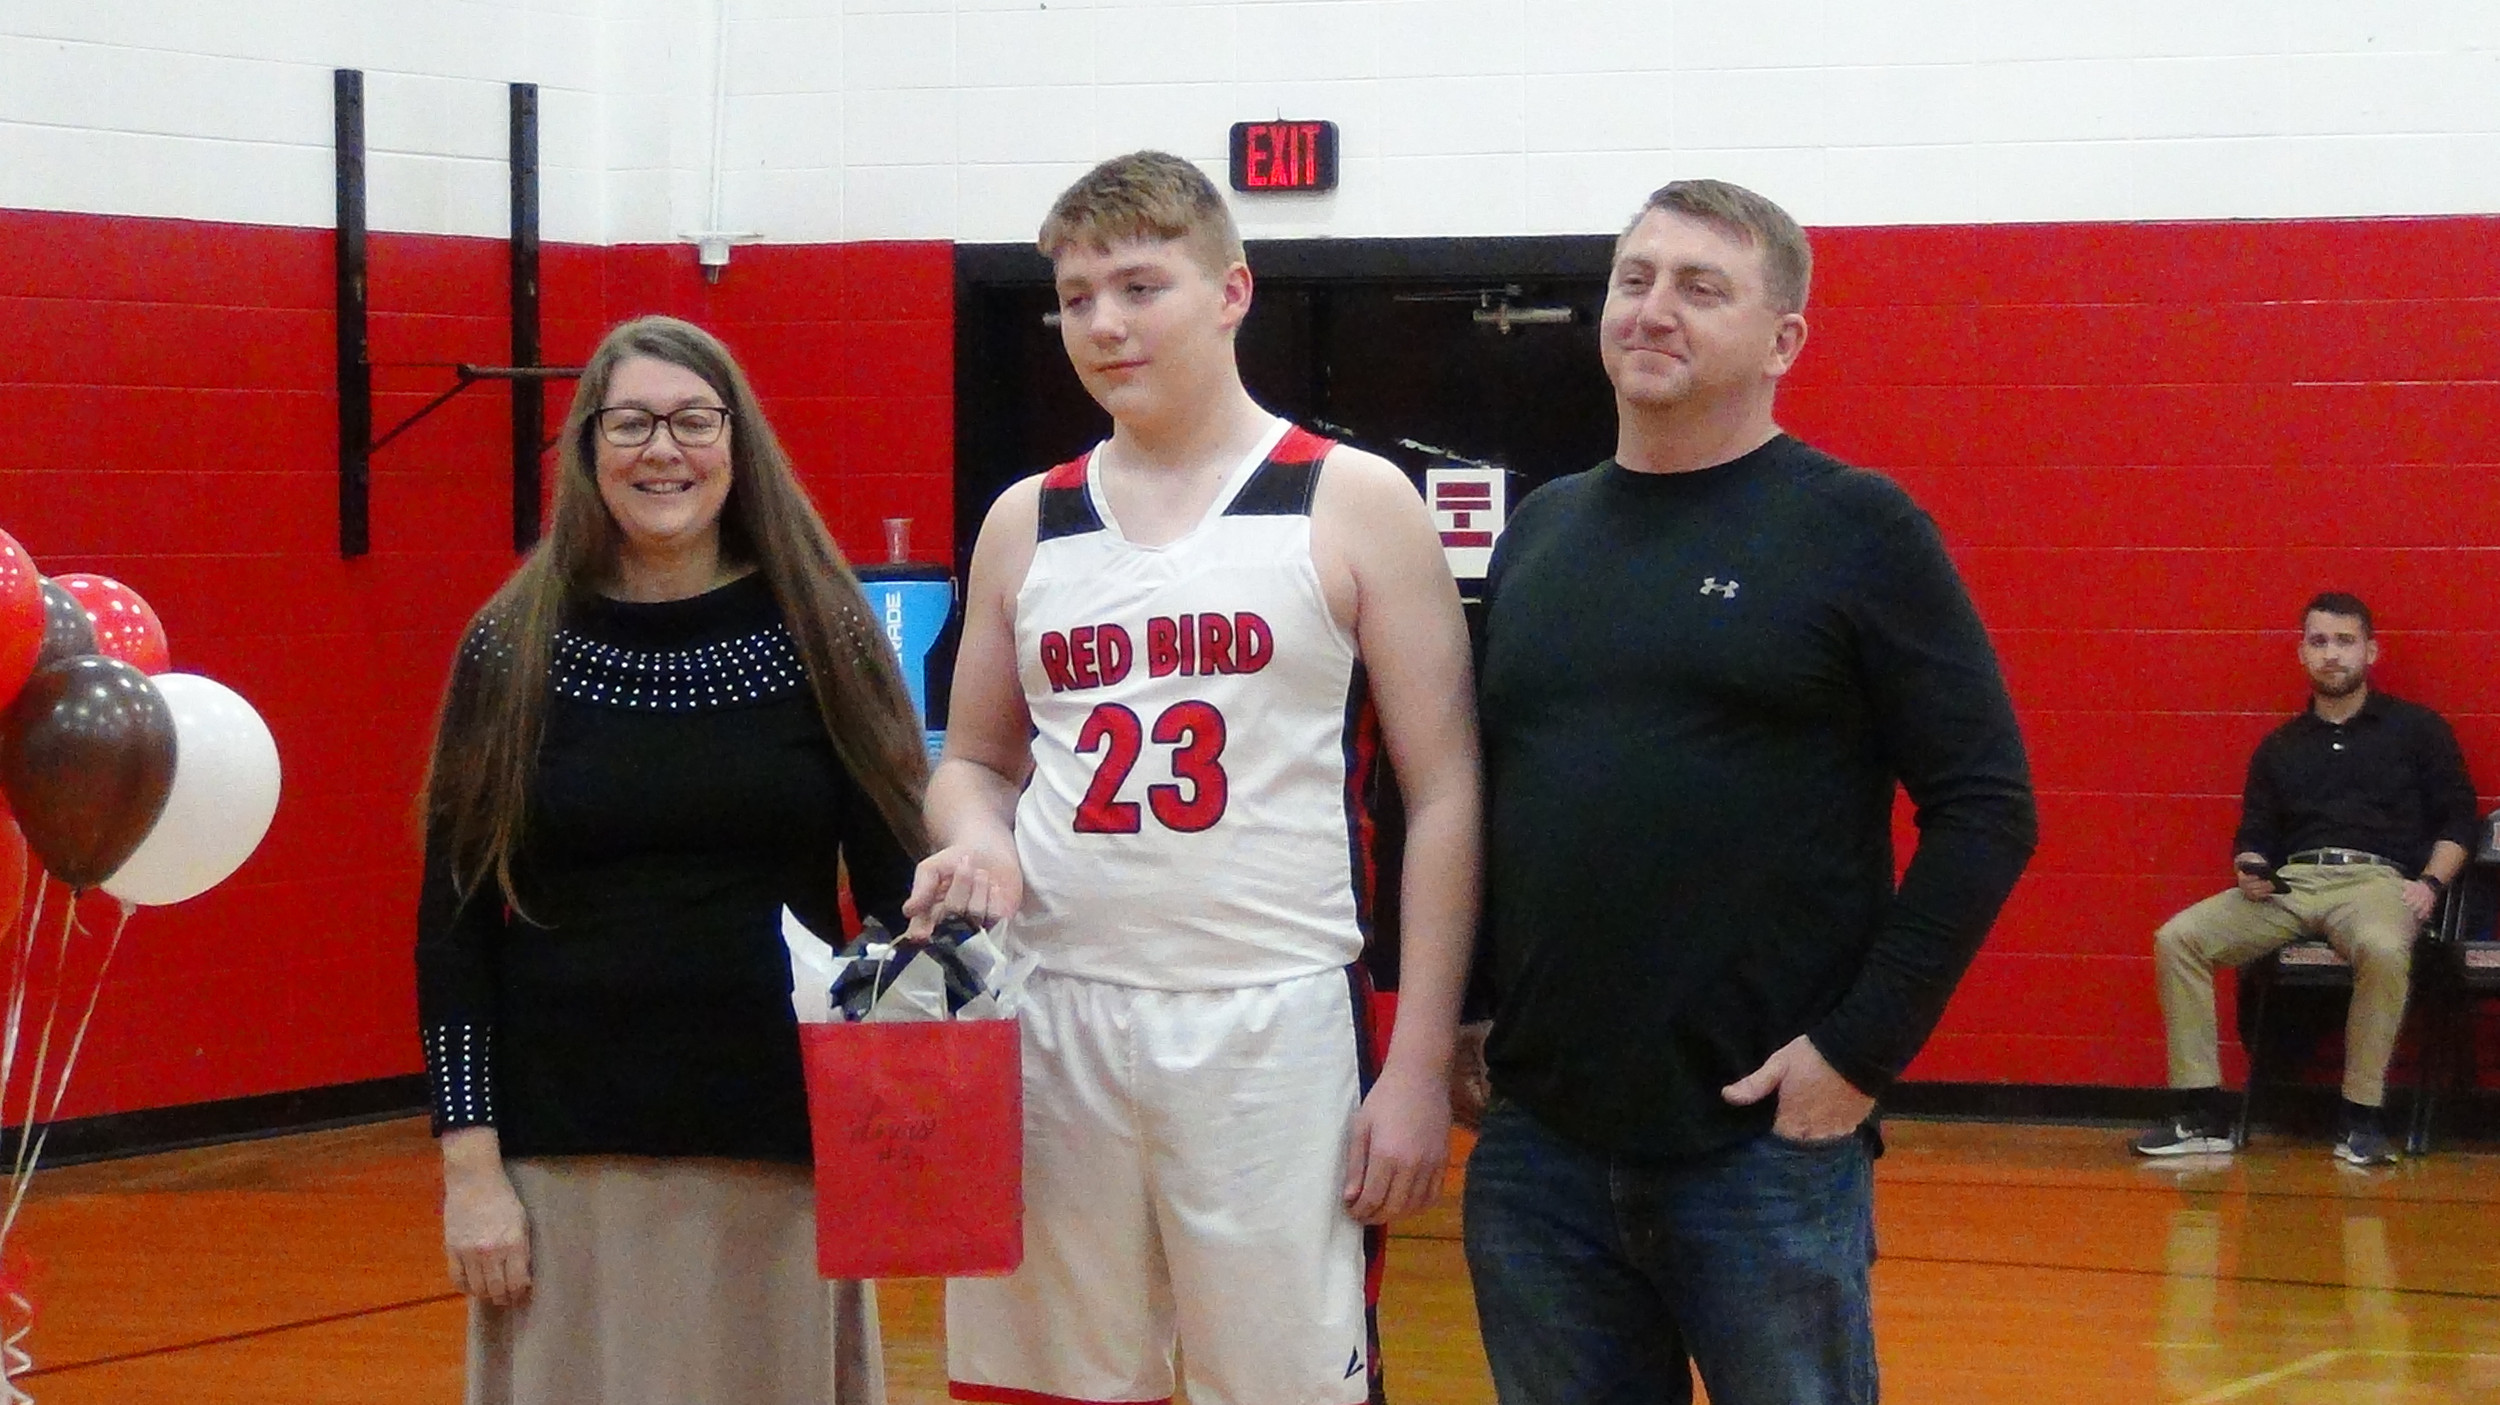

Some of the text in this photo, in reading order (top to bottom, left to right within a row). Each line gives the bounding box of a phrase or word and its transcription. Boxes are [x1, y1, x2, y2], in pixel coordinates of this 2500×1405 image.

[1247, 124, 1321, 187] EXIT
[1040, 612, 1274, 692] RED BIRD
[1073, 700, 1228, 834] 23
